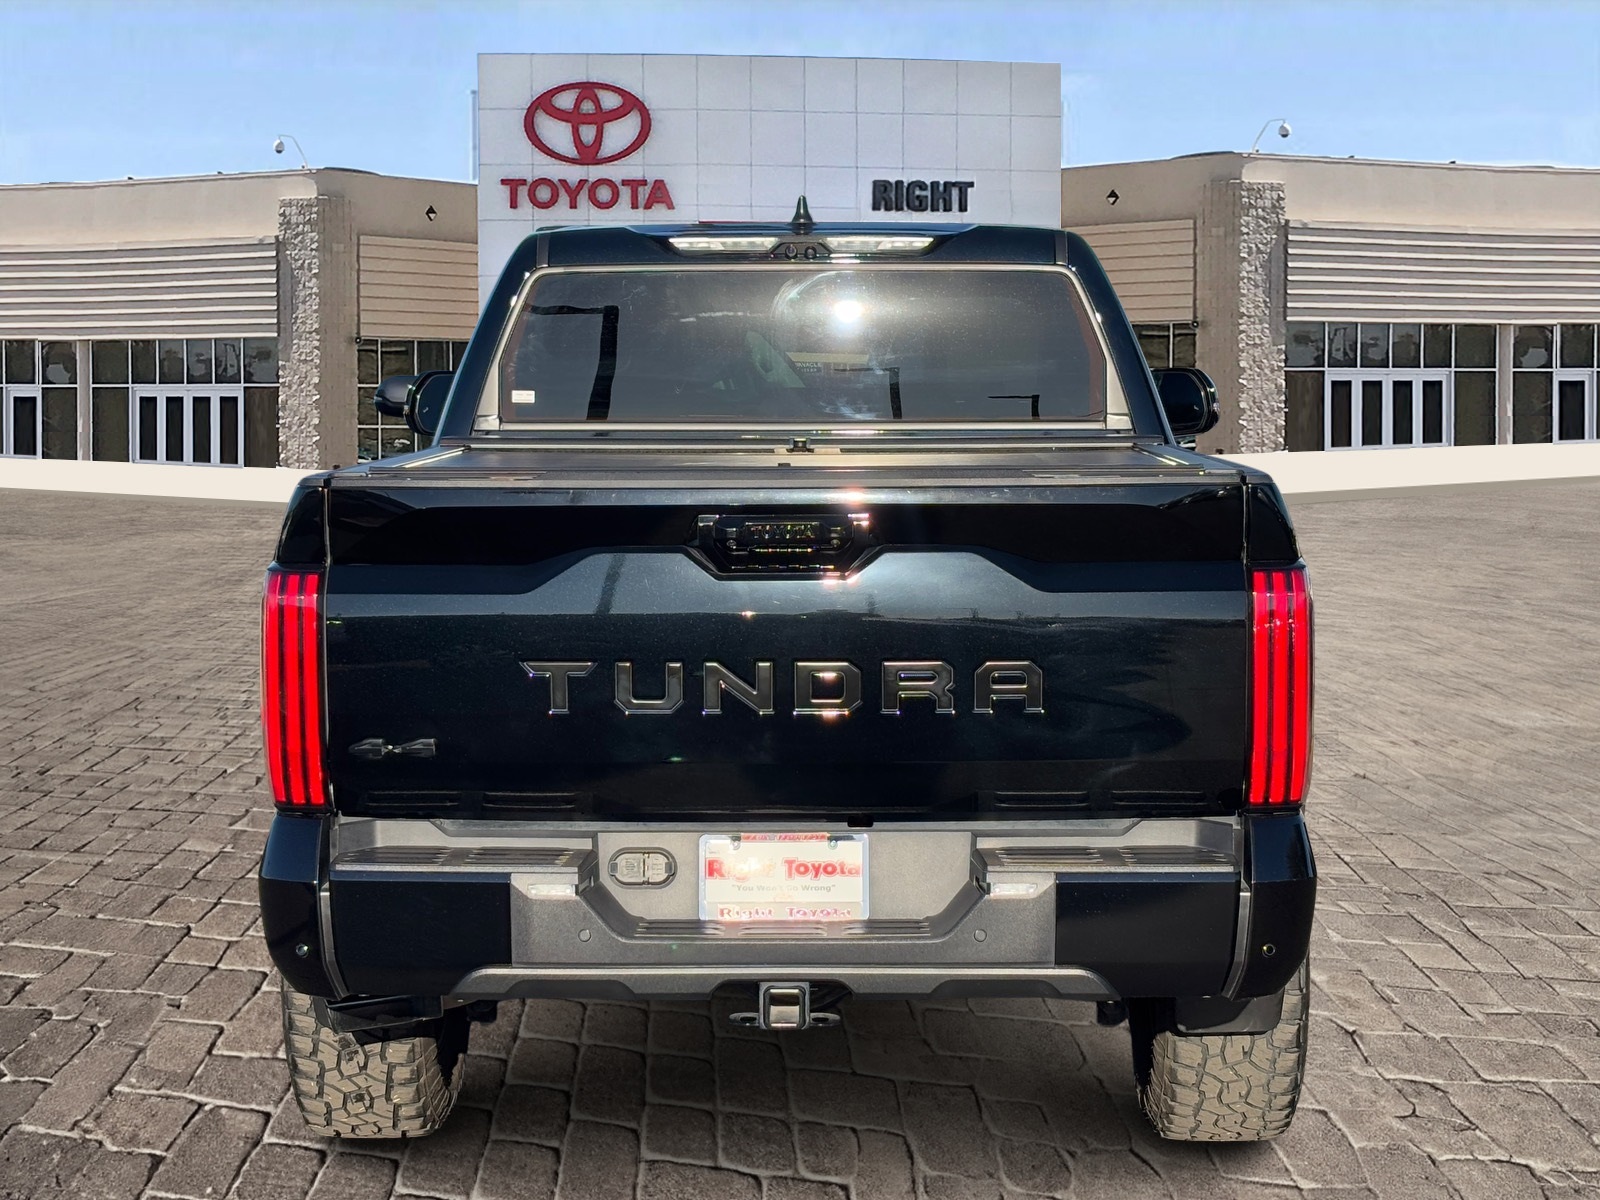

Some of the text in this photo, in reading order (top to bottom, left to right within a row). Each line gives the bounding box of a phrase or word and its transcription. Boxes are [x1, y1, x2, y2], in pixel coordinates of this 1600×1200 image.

[500, 178, 675, 211] TOYOTA
[871, 179, 975, 213] RIGHT
[750, 524, 816, 540] TOYOTA
[518, 661, 1045, 715] TUNDRA
[783, 857, 862, 881] Toyota
[719, 905, 851, 919] Right Toyota
